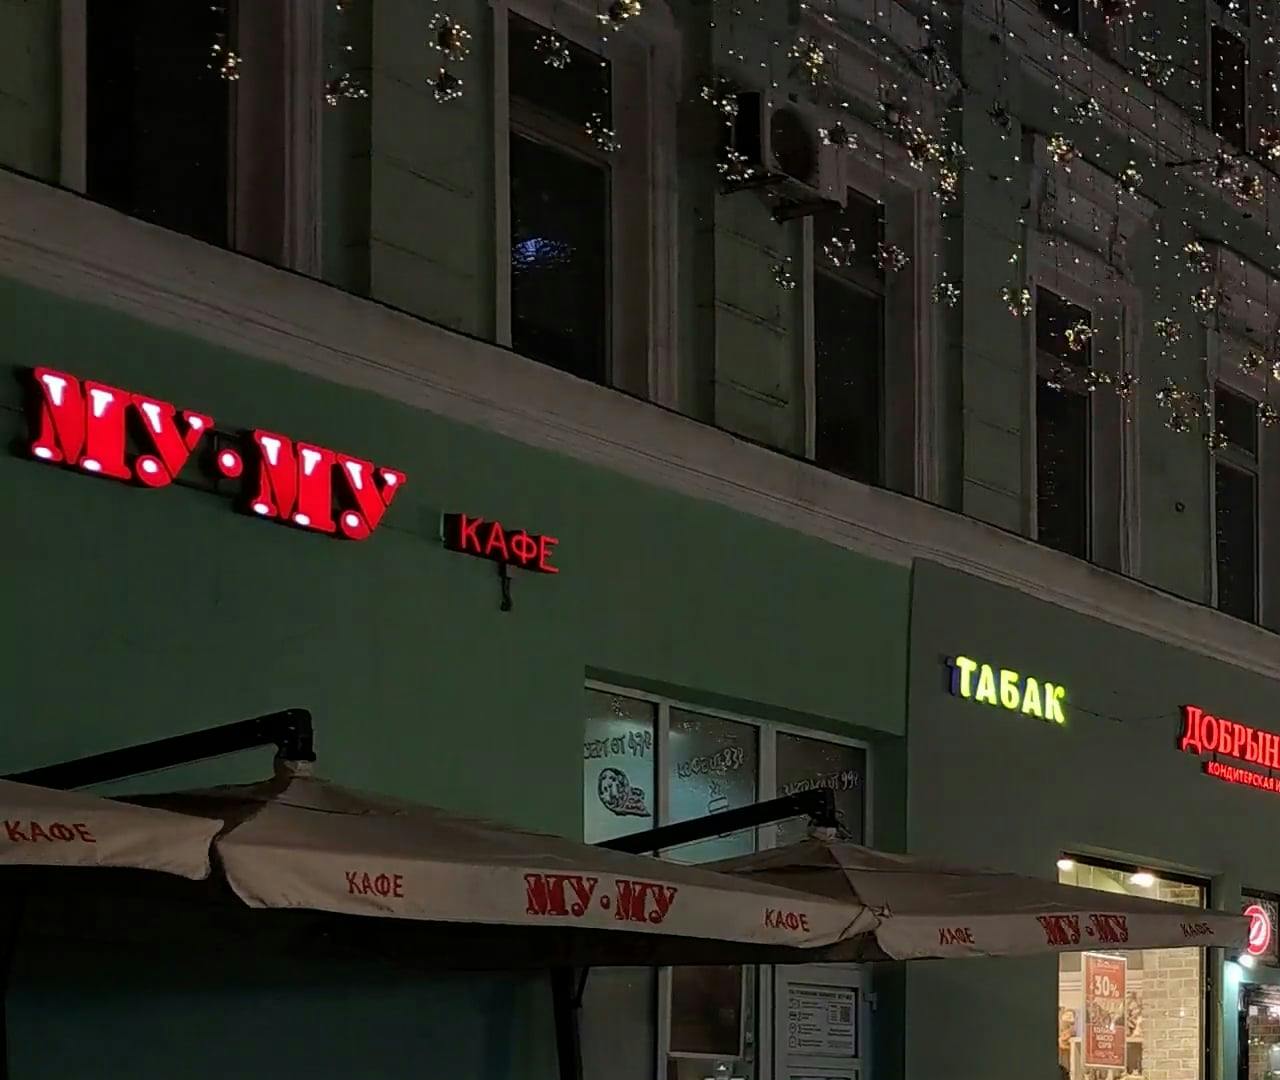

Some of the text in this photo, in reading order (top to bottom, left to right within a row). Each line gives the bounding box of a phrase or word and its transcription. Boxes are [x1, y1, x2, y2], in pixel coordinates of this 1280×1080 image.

[458, 512, 560, 575] КАФЕ
[954, 655, 1068, 726] ТАБАК
[1207, 759, 1274, 791] КОНДИТЕРСКАЯ
[4, 819, 97, 846] КАФЕ
[346, 870, 405, 899] КАФЕ
[764, 907, 810, 933] КАФЕ
[938, 927, 976, 946] КАФЕ
